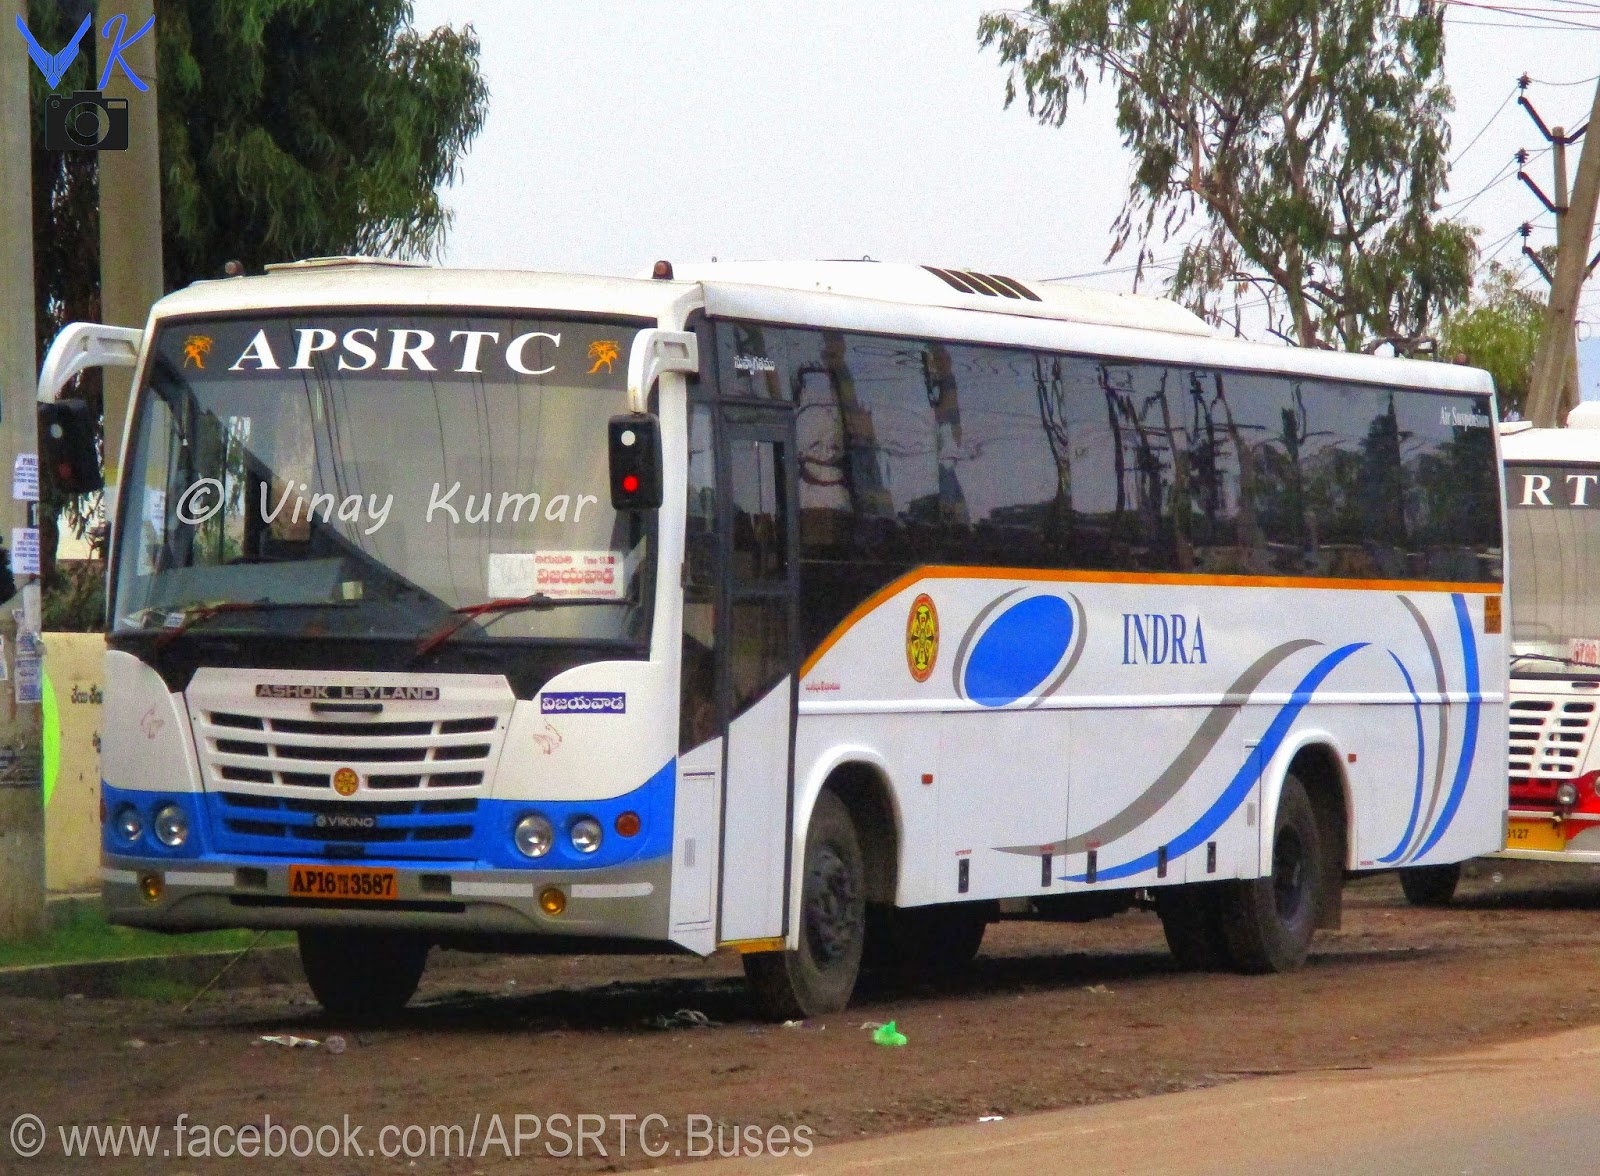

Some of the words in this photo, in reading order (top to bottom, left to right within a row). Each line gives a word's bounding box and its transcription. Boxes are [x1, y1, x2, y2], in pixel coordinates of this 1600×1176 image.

[227, 328, 562, 375] APSRTC
[536, 568, 615, 584] విజయవాడ
[1122, 614, 1208, 665] INDRA
[258, 684, 330, 698] ASHOK
[340, 686, 438, 700] LEYLAND
[542, 695, 624, 711] విజయవాడ
[327, 815, 374, 828] VIKING
